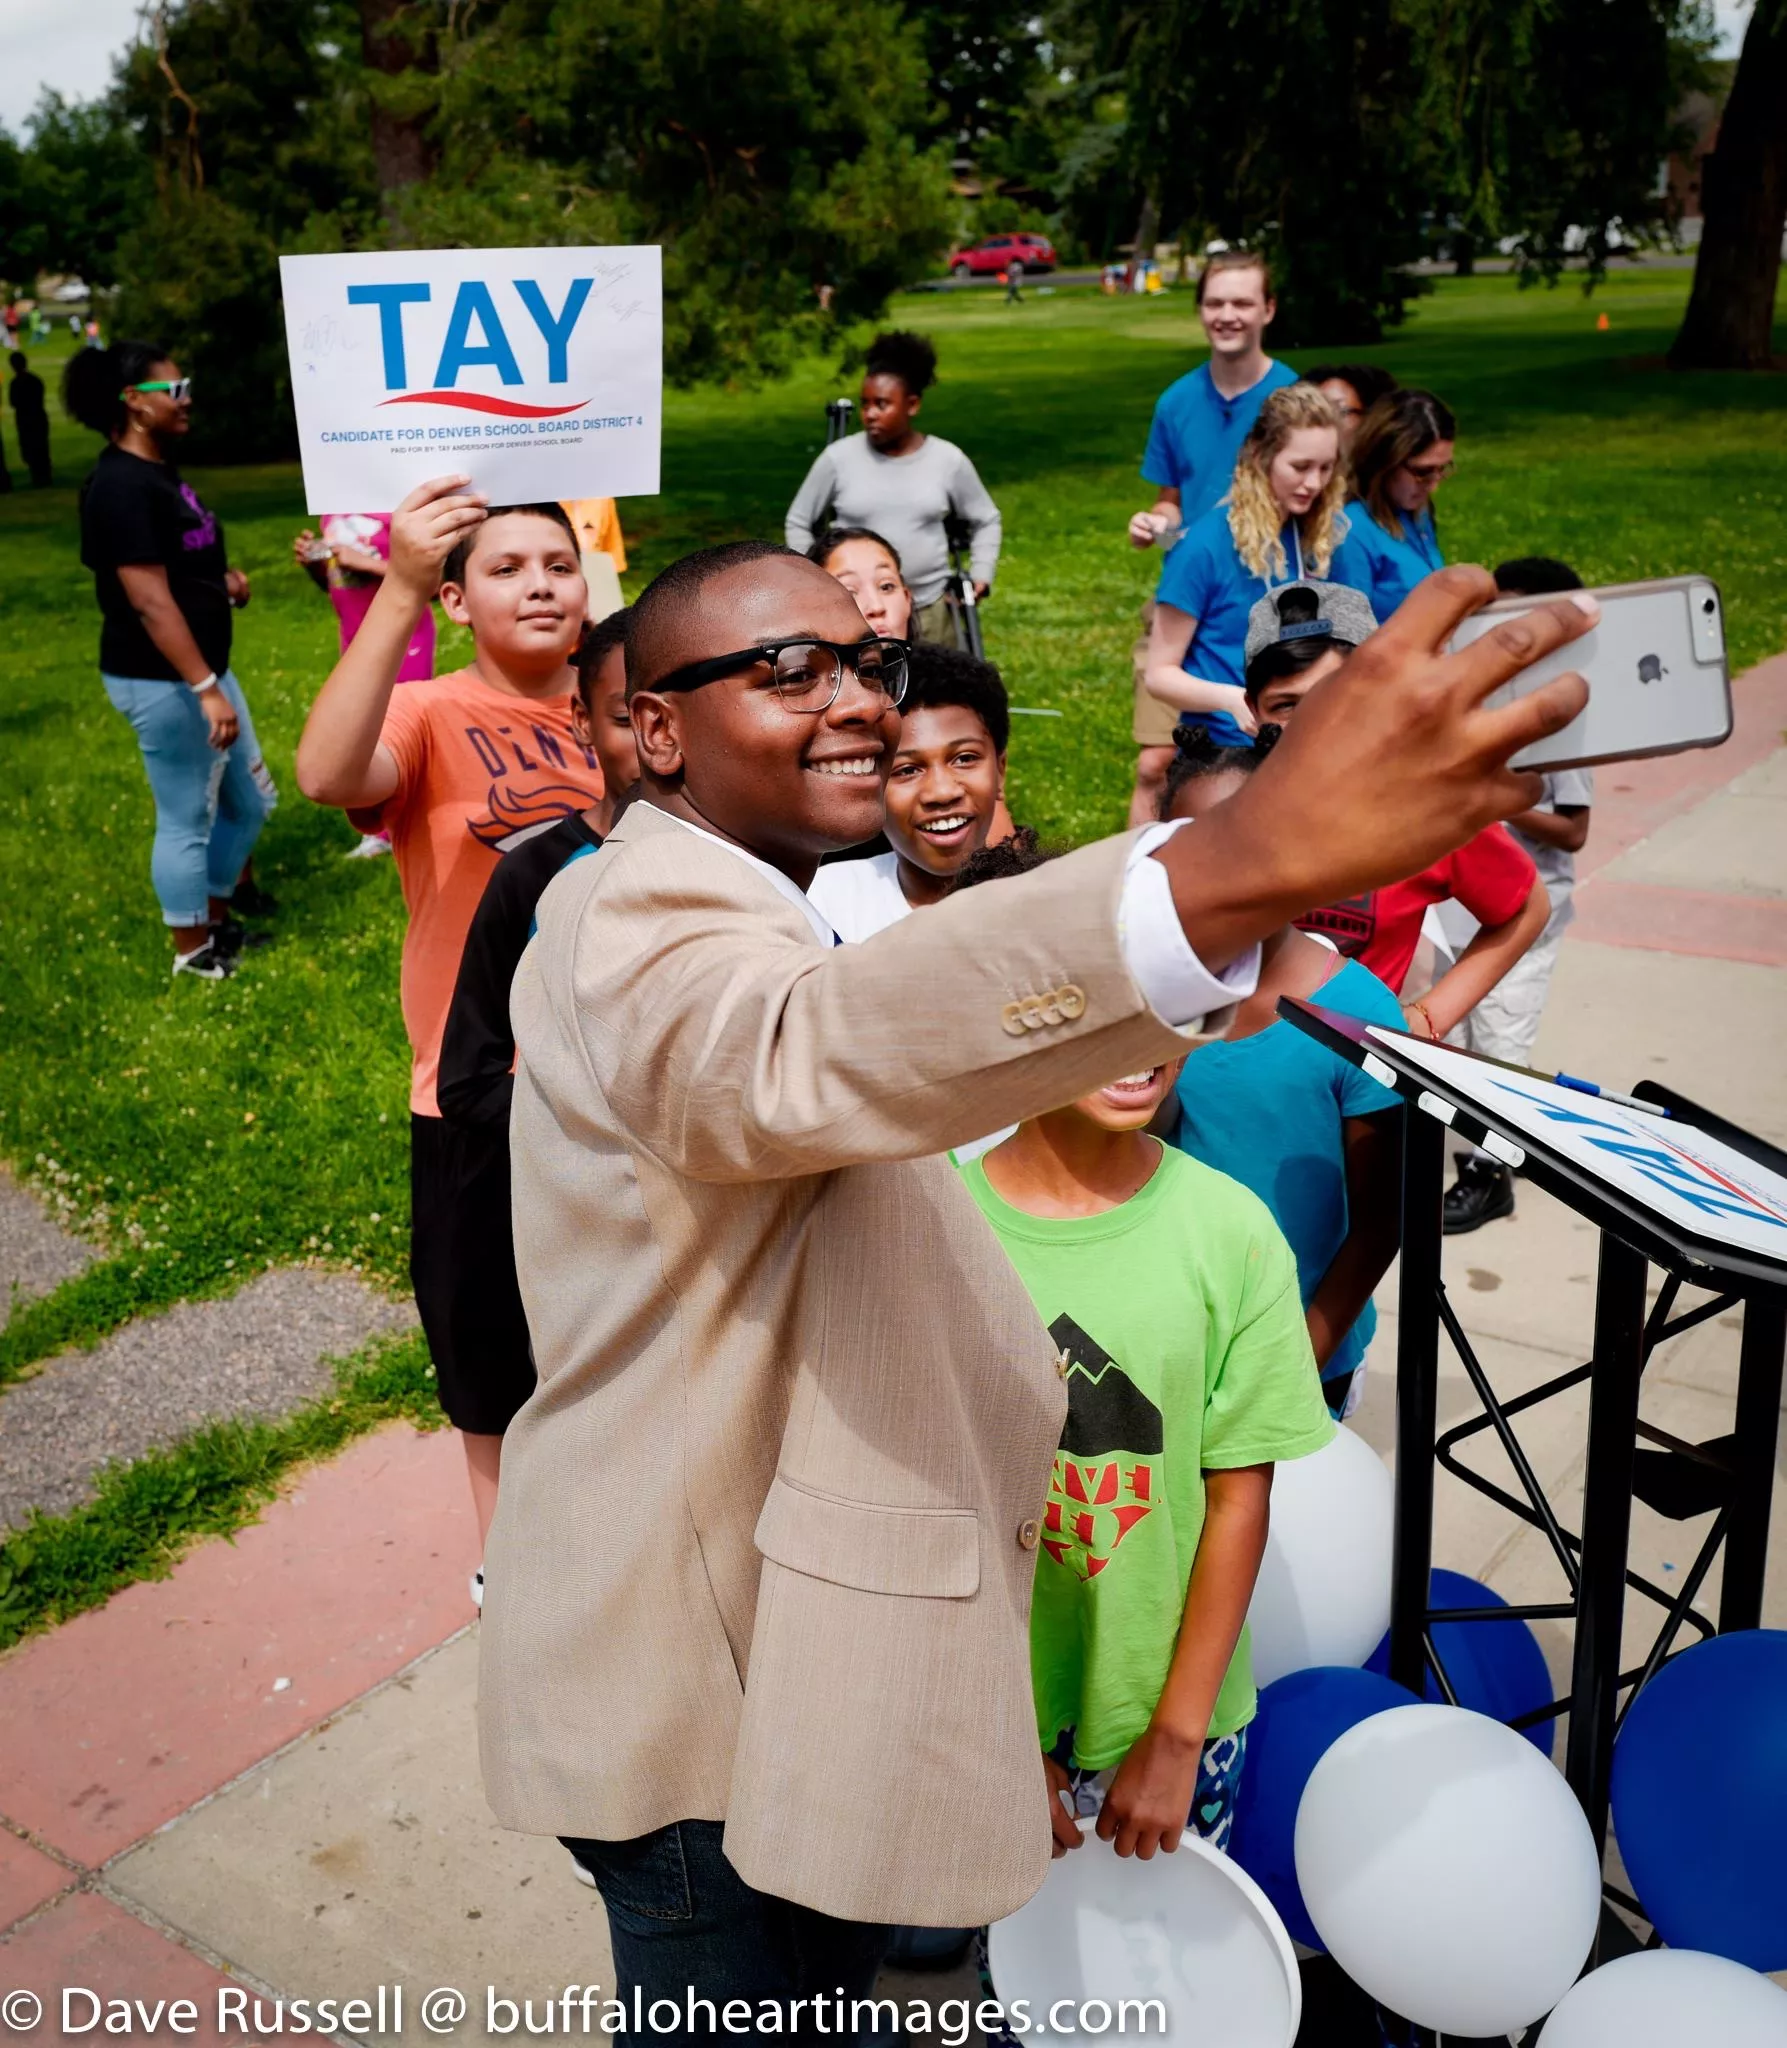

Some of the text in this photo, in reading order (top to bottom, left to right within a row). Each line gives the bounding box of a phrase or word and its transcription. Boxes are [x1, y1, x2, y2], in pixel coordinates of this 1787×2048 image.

[347, 278, 595, 391] TAY
[321, 416, 643, 443] CANDIDATE FOR DENVER SCHOOL BOARD DISTRICT 4
[452, 443, 490, 451] ANDERSON
[506, 440, 532, 449] DENVER
[533, 438, 559, 446] SCHOOL
[560, 437, 583, 445] BOARD
[1484, 1077, 1787, 1228] TAY
